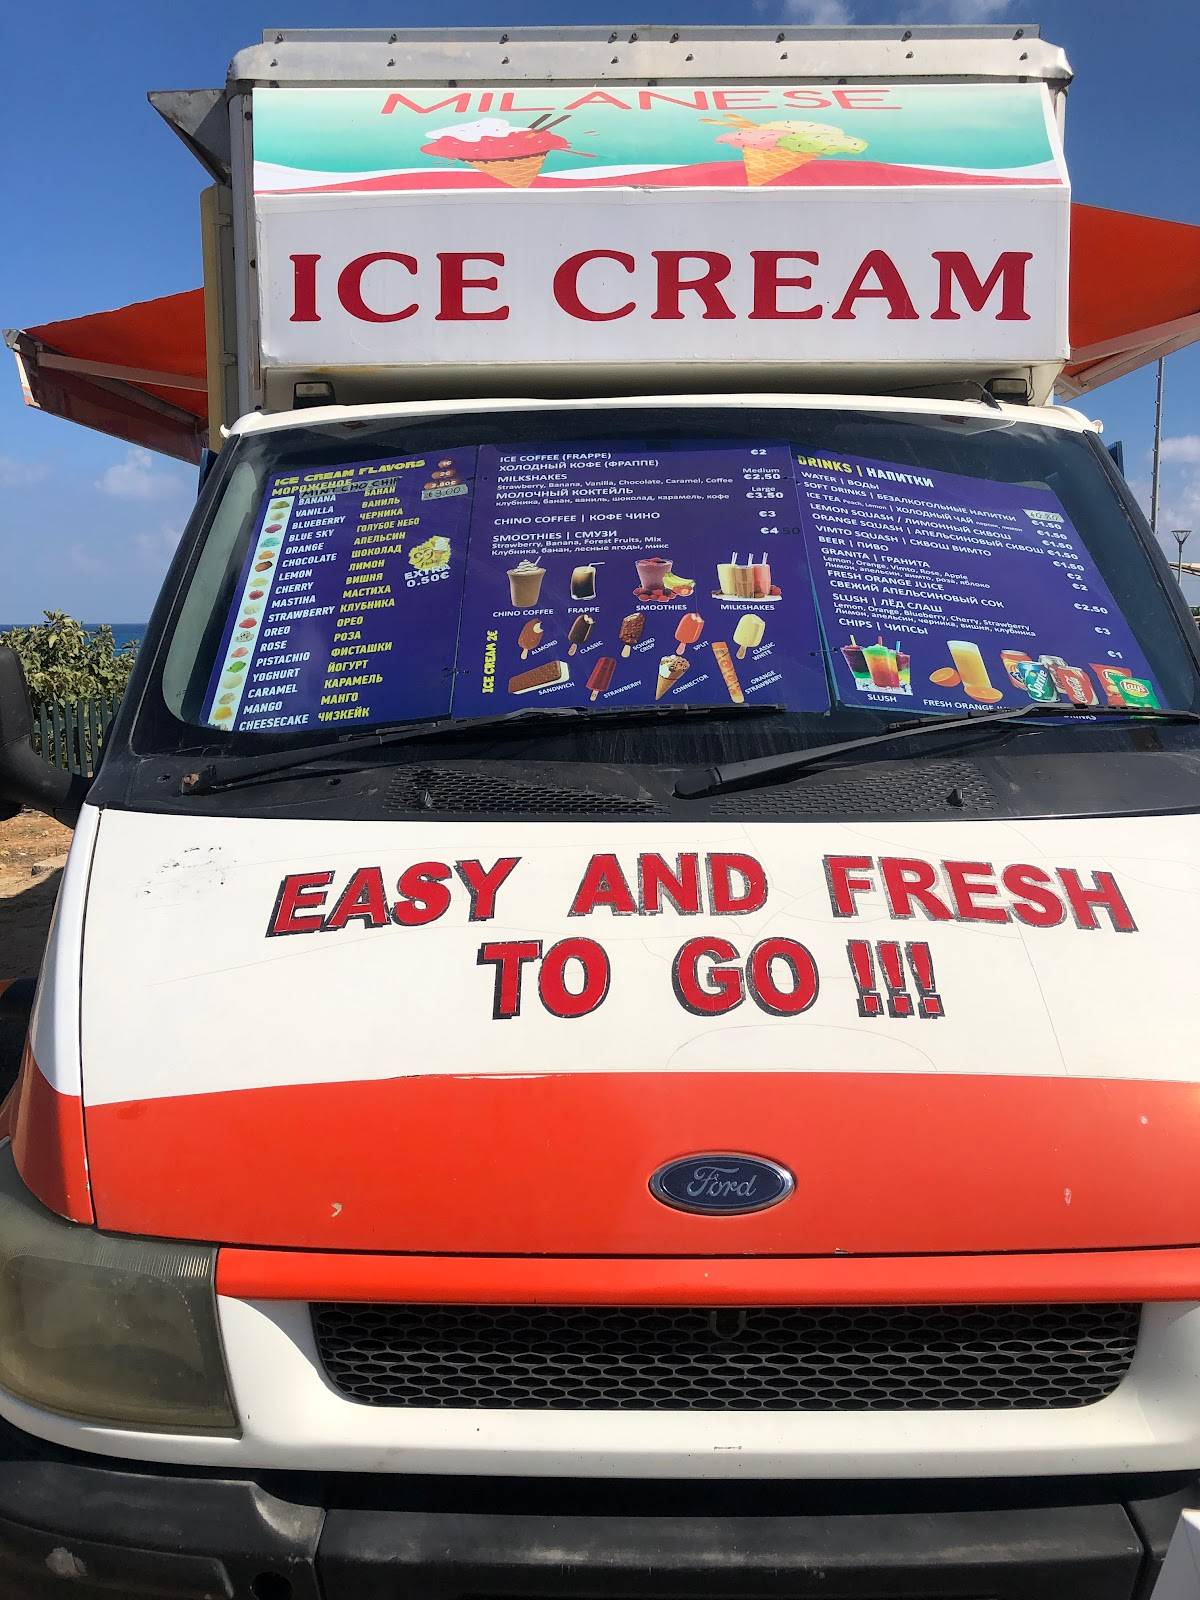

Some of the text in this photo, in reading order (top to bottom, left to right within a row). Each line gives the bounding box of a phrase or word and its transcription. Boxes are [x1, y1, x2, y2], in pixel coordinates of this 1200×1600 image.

[380, 88, 903, 115] MILANESE
[289, 248, 1034, 323] ICE CREAM
[519, 454, 559, 462] COFFEE
[562, 452, 612, 461] (FRAPPE)
[499, 459, 659, 472] ХОЛОДНЫЙ КОФЕ (ФРАППЕ)
[797, 454, 935, 488] DRINKS НАПИТКИ
[274, 460, 425, 486] ICE CREAM FLAVORS
[497, 473, 568, 483] MILKSHAKES
[497, 483, 546, 491] Strawberry,
[548, 481, 583, 489] Banana,
[585, 480, 616, 488] Vanilla,
[618, 478, 663, 486] Chocolate,
[666, 477, 704, 485] Caramel,
[800, 471, 880, 490] WATER ВОДЫ
[364, 486, 396, 498] БАНАН
[496, 487, 634, 500] МОЛОЧНЫЙ КОКТЕЙЛЬ
[298, 494, 337, 505] BANANA
[361, 497, 401, 509] ВАНИЛЬ
[803, 481, 829, 491] SOFT
[830, 485, 867, 497] DRINKS
[877, 493, 968, 514] БЕЗАЛКОГОЛЬНЫЕ
[970, 509, 1017, 522] НАПИТКИ
[296, 506, 334, 518] VANILLA
[359, 508, 404, 521] ЧЕРНИКА
[758, 510, 777, 518] €3
[805, 491, 974, 525] ICE TEA ХОЛОДНЫЙ ЧАЙ
[292, 515, 346, 530] BLUEBERRY
[357, 517, 420, 533] ГОЛУБОЕ НЕБО
[494, 512, 661, 526] CHINO COFFEE КОФЕ ЧИНО
[809, 503, 849, 515] LEMON
[851, 509, 894, 522] SQUASH
[905, 517, 971, 534] ЛИМОННЫЙ
[973, 528, 1011, 540] СКВОШ
[1031, 520, 1062, 530] €1.50
[289, 529, 335, 542] BLUE SKY
[353, 531, 406, 546] АПЕЛЬСИН
[492, 530, 617, 543] SMOOTHIES СМУЗИ
[812, 513, 1045, 554] ORANGE SQUASH АПЕЛЬСИНОВЫЙ СКВОШ
[815, 524, 992, 557] VIMTO SQUASH СКВОШ ВИМТО
[1036, 530, 1067, 540] €1.50
[285, 543, 325, 555] ORANGE
[818, 535, 889, 551] BEER ПИВО
[1041, 539, 1073, 550] €1.50
[351, 545, 402, 559] ШОКОЛАД
[821, 547, 931, 568] GRANITA ГРАНИТА
[1047, 549, 1079, 560] €1.50
[282, 553, 337, 568] CHOCOLATE
[348, 560, 385, 572] ЛИМОН
[1053, 560, 1085, 571] €1.50
[278, 569, 312, 581] LEMON
[345, 573, 383, 585] ВИШНЯ
[407, 571, 450, 587] 0.50€
[827, 569, 945, 591] FRESH ORANGE JUICE
[1066, 572, 1084, 581] €2
[275, 582, 314, 595] CHERRY
[343, 585, 391, 598] МАСТИХА
[829, 580, 1005, 609] СВЕЖИЙ АПЕЛЬСИНОВЫЙ СОК
[1071, 583, 1089, 592] €2
[271, 595, 316, 609] MASTIHA
[339, 599, 395, 614] КЛУБНИКА
[636, 604, 687, 612] SMOOTHIES
[832, 592, 943, 613] SLUSH ЛЁД СЛАШ
[1073, 603, 1108, 614] €2.50
[267, 606, 335, 623] STRAWBERRY
[492, 608, 554, 618] CHINO COFFEE
[567, 606, 600, 614] FRAPPE
[337, 616, 363, 628] ОРЕО
[838, 617, 929, 635] CHIPS ЧИПСЫ
[264, 626, 291, 638] OREO
[334, 631, 361, 642] РОЗА
[1094, 626, 1111, 636] €3
[260, 640, 288, 652] ROSE
[331, 642, 393, 657] ФИСТАШКИ
[531, 640, 558, 656] ALMOND
[580, 640, 604, 654] CLASSIC
[692, 640, 710, 651] SPLIT
[752, 641, 776, 655] CLASSIC
[256, 652, 310, 668] PISTACHIO
[484, 644, 497, 675] CREAM
[752, 650, 773, 661] WHITE
[327, 659, 369, 673] ЙОГУРТ
[252, 668, 300, 682] YOGHURT
[324, 674, 383, 689] КАРАМЕЛЬ
[750, 670, 777, 685] ORANGE
[248, 683, 298, 699] CARAMEL
[538, 682, 575, 696] SANDWICH
[603, 680, 642, 699] STRAWBERRY
[672, 674, 709, 695] CONNECTOR
[744, 673, 783, 695] STRAWBERRY
[320, 692, 359, 705] МАНГО
[867, 693, 897, 703] SLUSH
[923, 699, 952, 709] FRESH
[243, 701, 283, 715] MANGO
[318, 707, 370, 722] ЧИЗКЕЙК
[239, 713, 309, 732] CHEESECAKE
[265, 852, 1139, 938] EASY AND FRESH
[476, 936, 945, 1020] TO GO !!!
[687, 1166, 757, 1197] Ford
